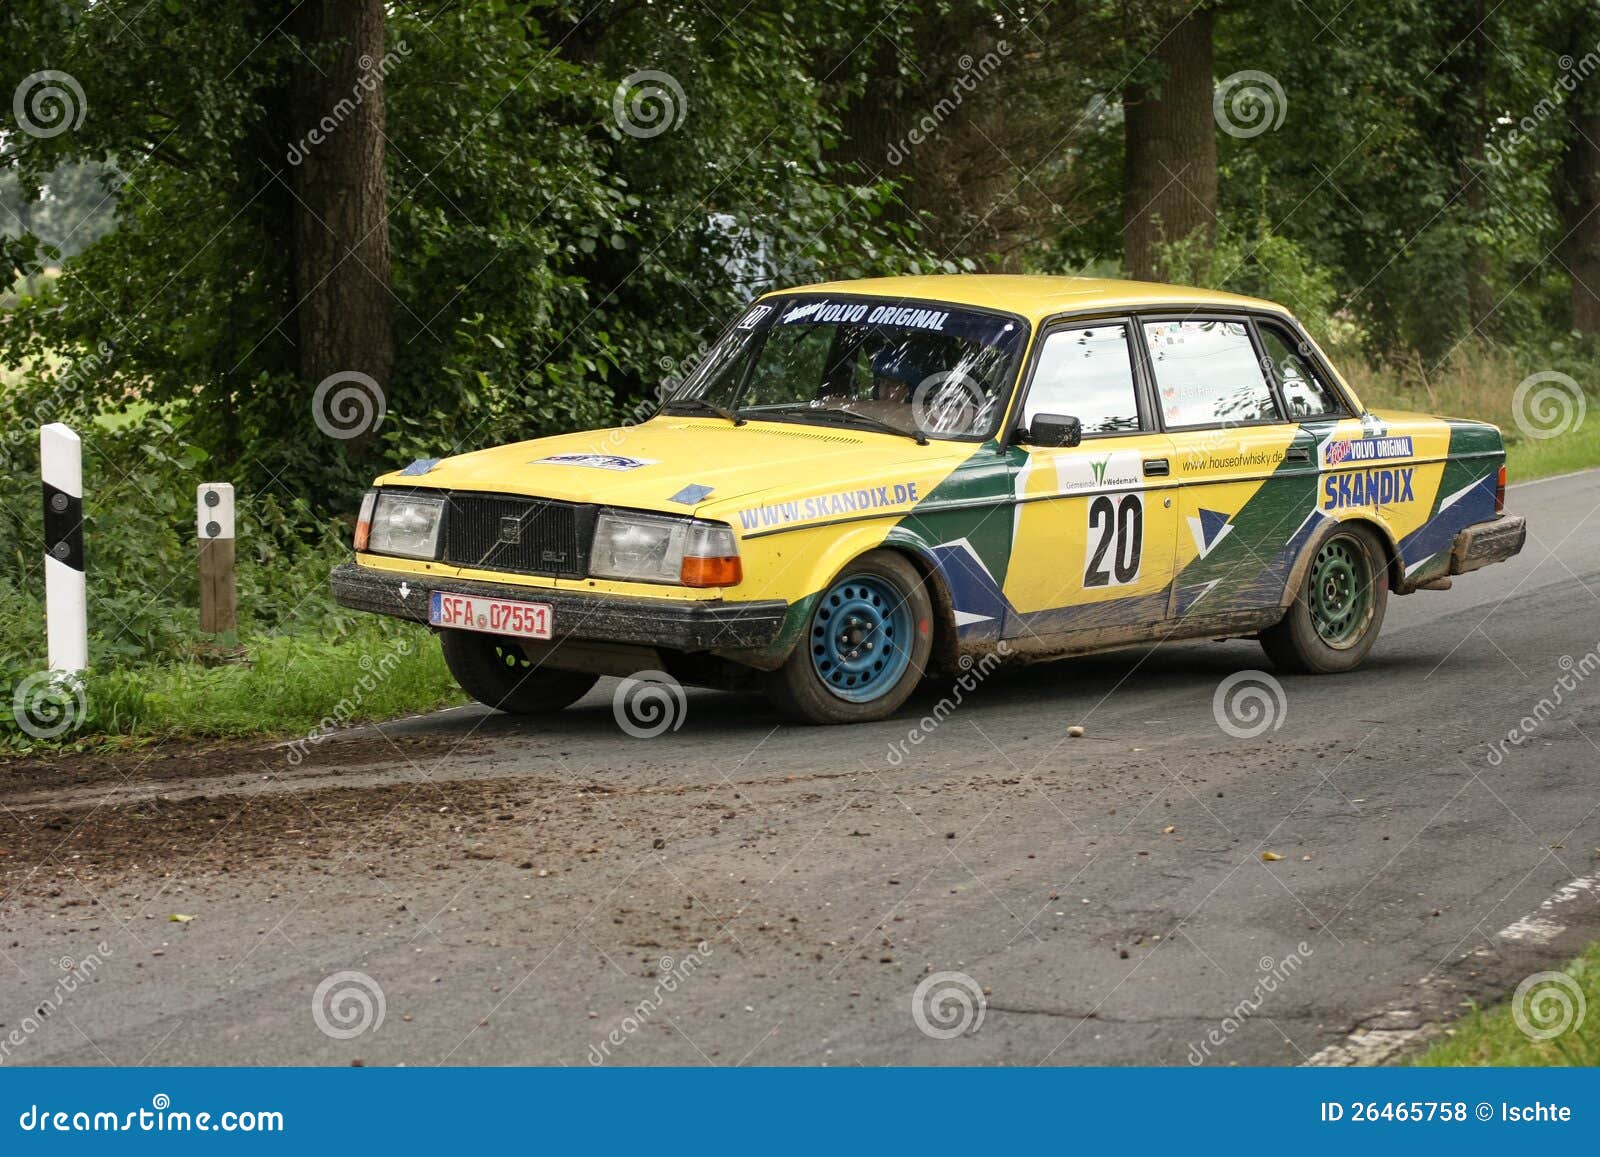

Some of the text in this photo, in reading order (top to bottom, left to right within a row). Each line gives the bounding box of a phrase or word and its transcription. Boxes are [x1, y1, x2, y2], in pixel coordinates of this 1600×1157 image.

[740, 306, 769, 327] 20
[813, 304, 868, 323] VOLVO
[868, 306, 949, 330] ORIGINAL
[1182, 450, 1283, 471] www.houseofwhisky.de
[1351, 441, 1375, 459] VOLVO
[1376, 438, 1411, 457] ORIGINAL
[1066, 476, 1138, 489] Gemeinde Wedemark
[1324, 468, 1414, 510] SKANDIX
[738, 482, 919, 530] WWW.SKANDIX.DE
[1083, 494, 1143, 587] 20
[442, 597, 547, 634] SFA 07551
